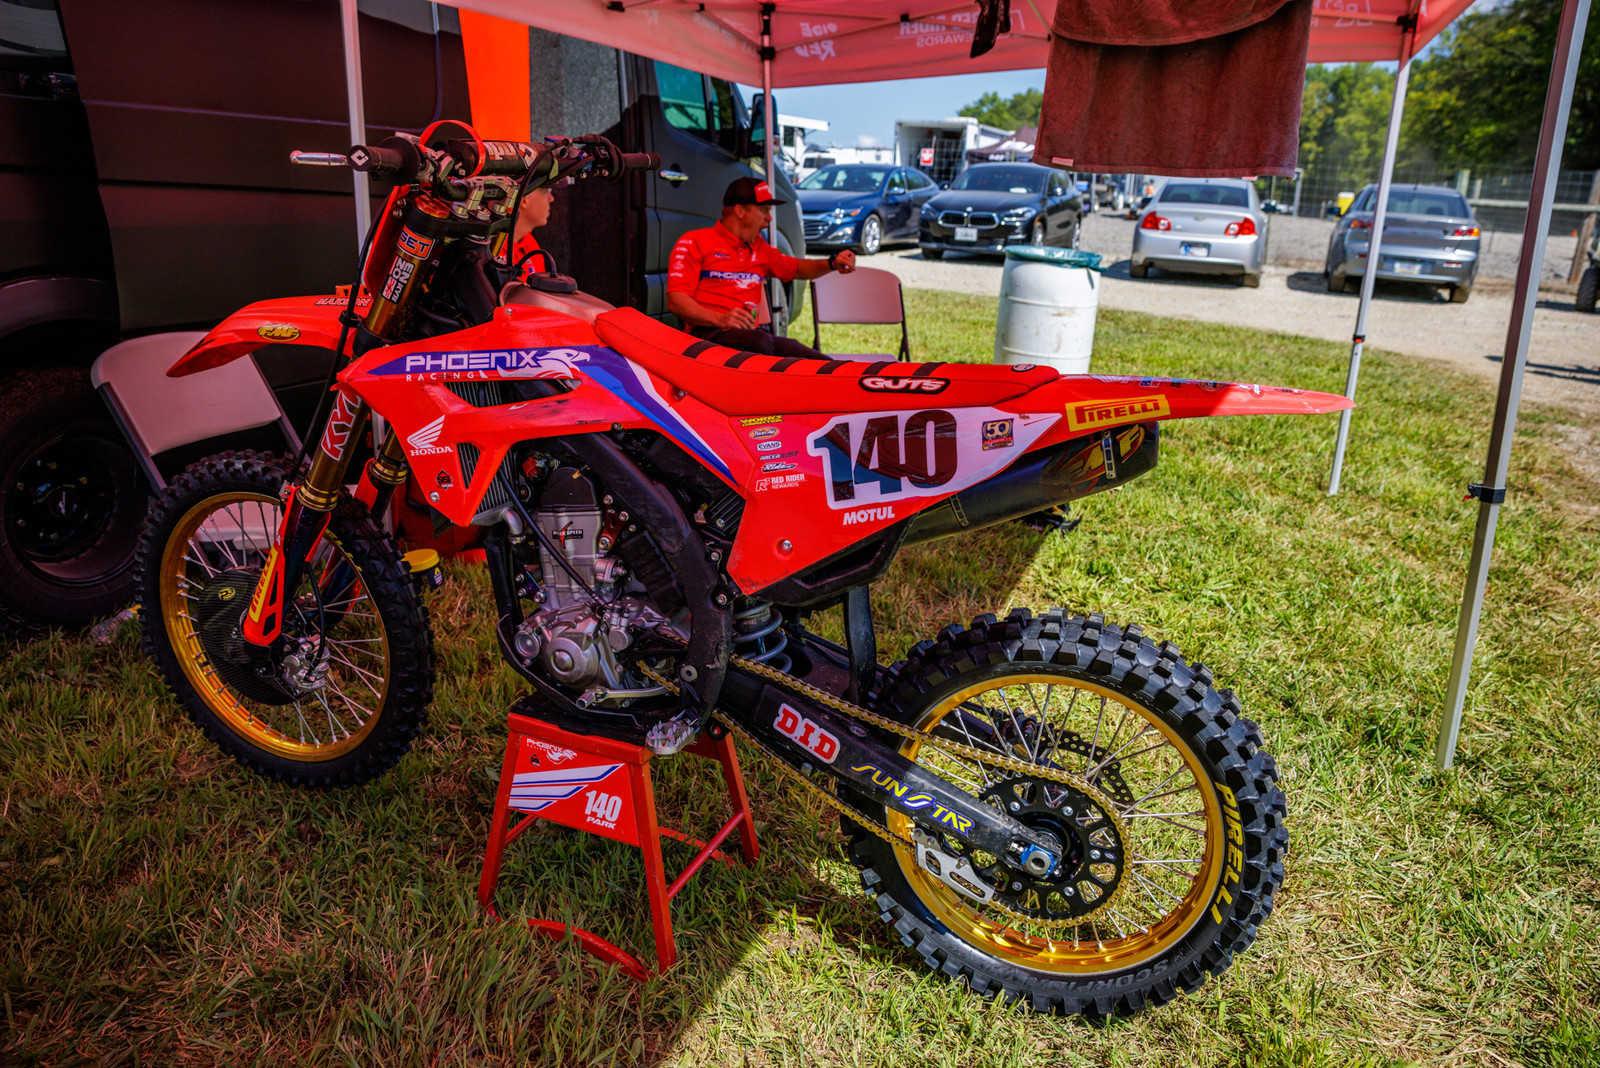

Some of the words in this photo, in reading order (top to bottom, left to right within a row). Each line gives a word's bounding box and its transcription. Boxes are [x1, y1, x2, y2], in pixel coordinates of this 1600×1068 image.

[258, 327, 300, 338] FMF
[405, 350, 541, 372] PHOENIX
[405, 371, 475, 382] RACING
[862, 377, 945, 391] GUTS
[1074, 399, 1160, 425] PIRELLI
[986, 421, 1010, 438] 50
[410, 446, 453, 457] HONDA
[759, 442, 780, 450] EVANS
[814, 410, 958, 502] 140
[771, 475, 784, 484] RED
[785, 473, 806, 482] RIDER
[771, 481, 799, 490] REWARDS
[842, 506, 895, 526] MOTUL
[526, 738, 563, 753] PHOENIX
[584, 790, 622, 822] 140
[586, 816, 616, 830] PARK
[1211, 781, 1244, 925] PIRELLI
